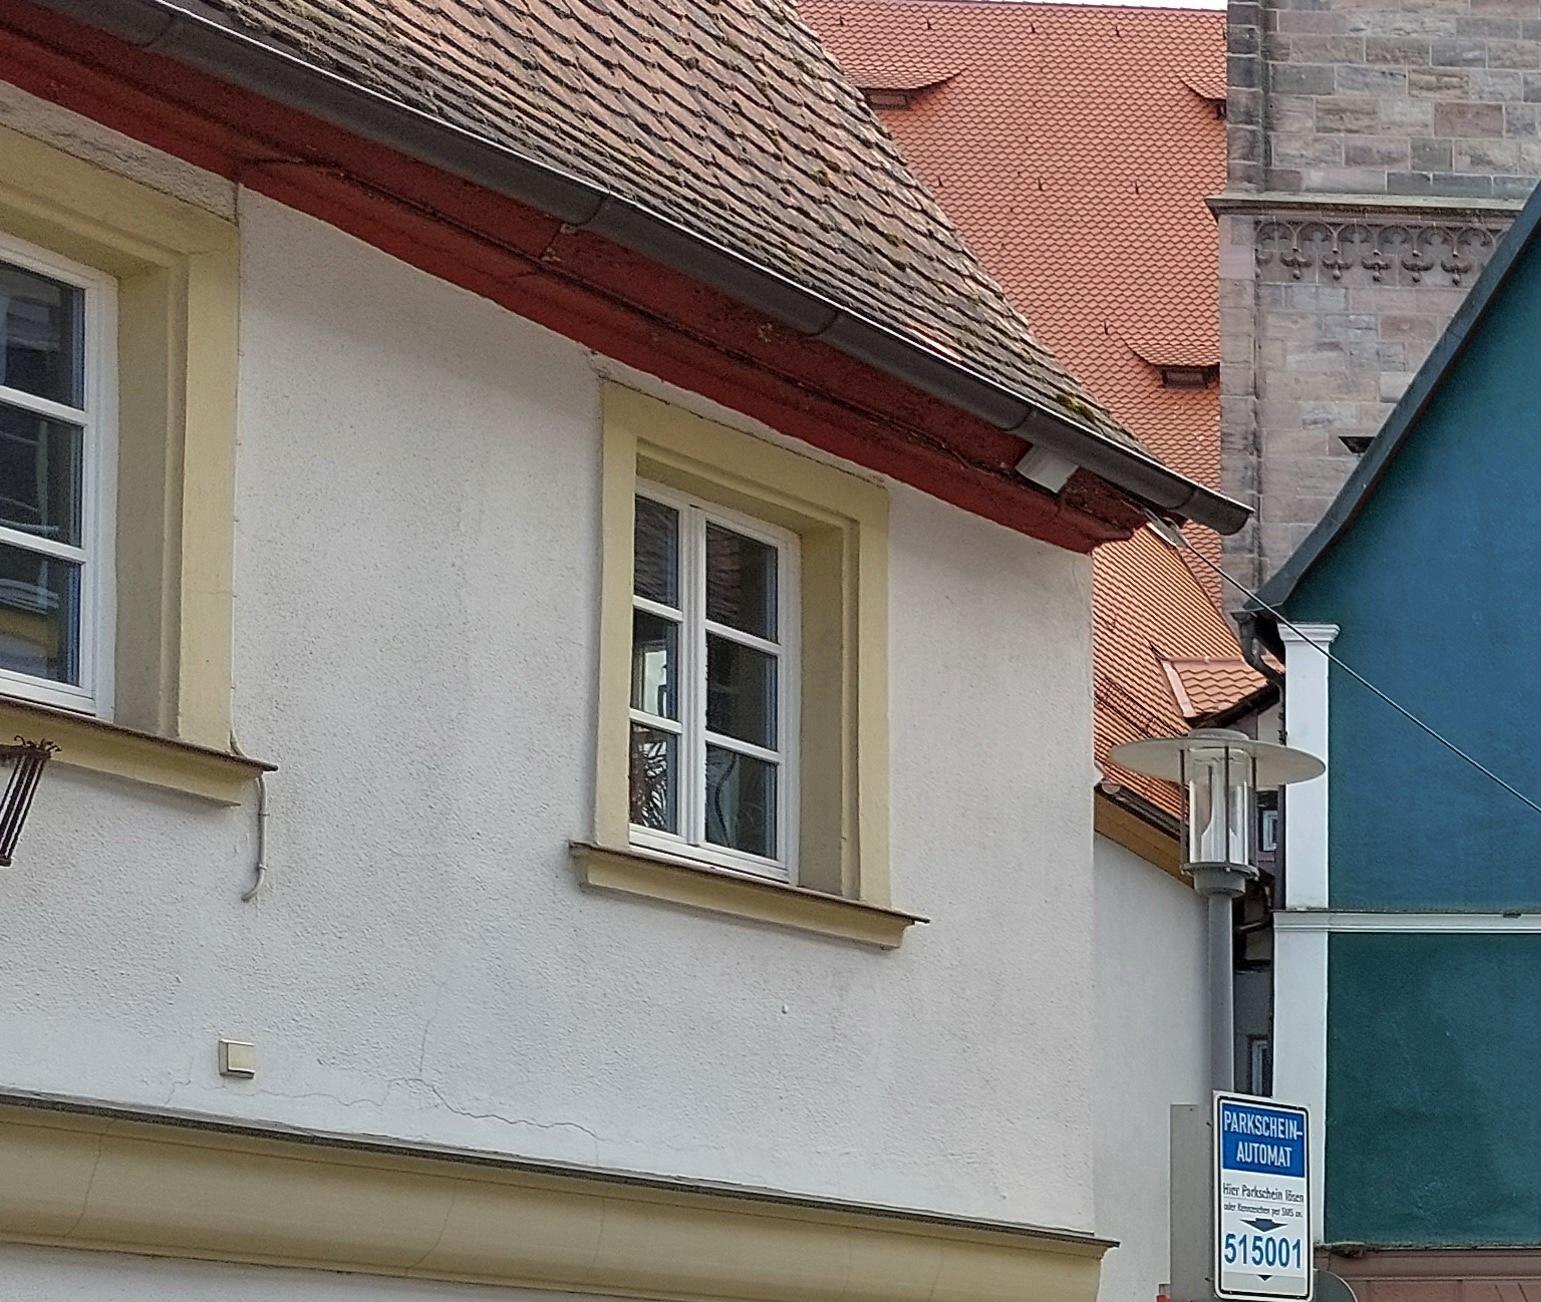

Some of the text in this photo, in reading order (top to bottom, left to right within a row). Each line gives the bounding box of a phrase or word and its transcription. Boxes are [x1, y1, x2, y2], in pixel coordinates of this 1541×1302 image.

[1223, 1110, 1303, 1141] PARKSCHEIN-
[1236, 1141, 1293, 1168] AUTOMAT
[1223, 1183, 1305, 1203] Hier Parkschein lösen
[1224, 1233, 1302, 1269] 515001
